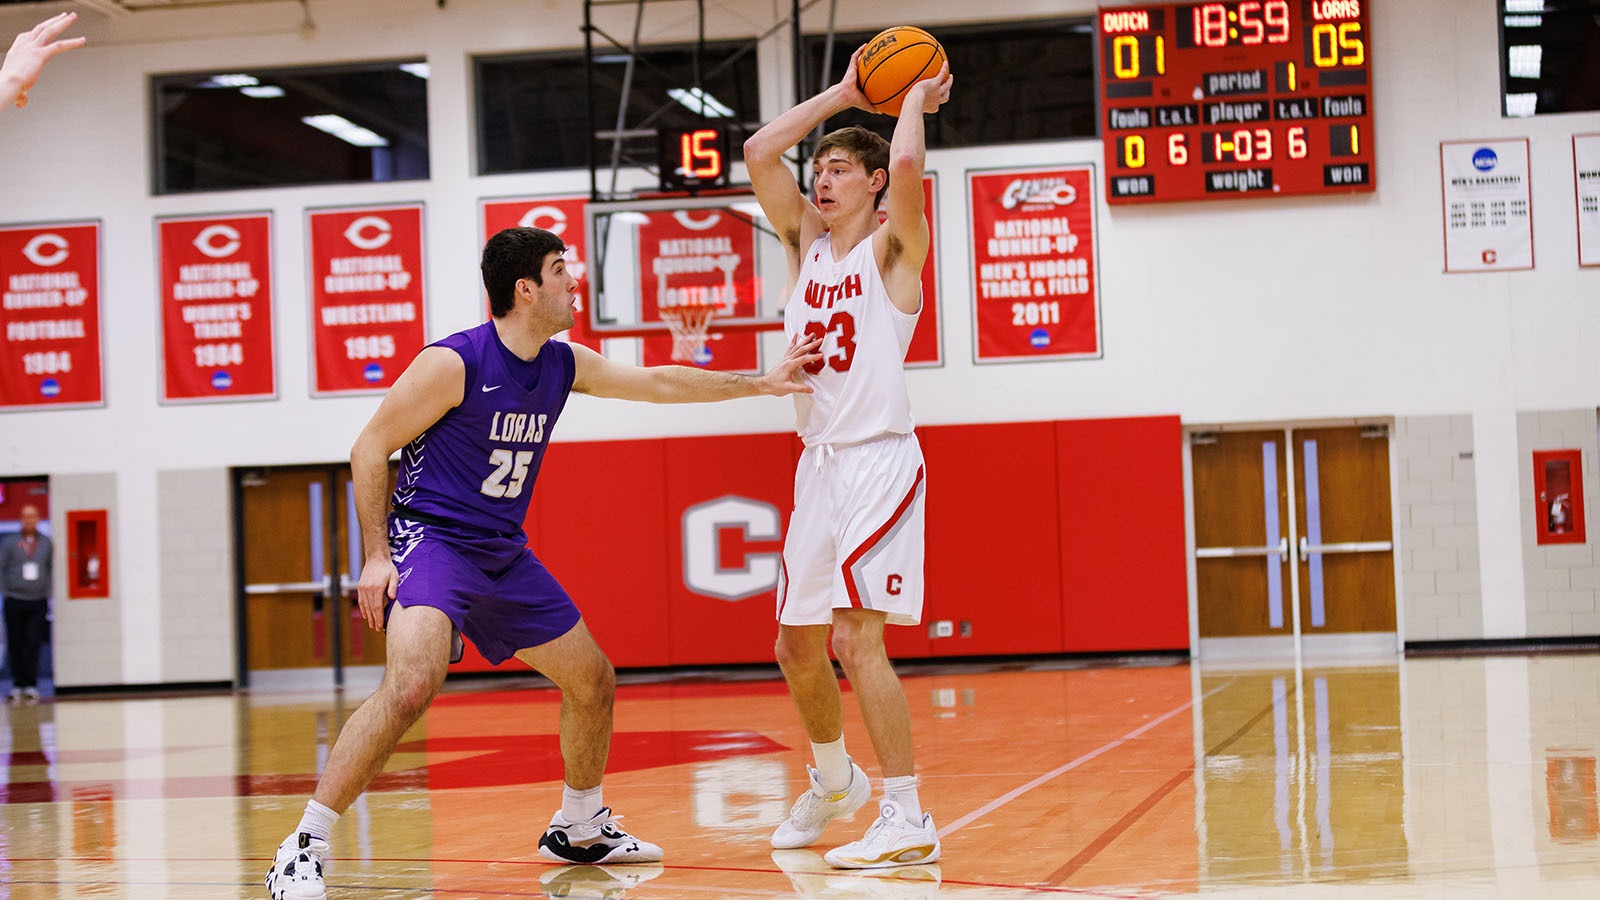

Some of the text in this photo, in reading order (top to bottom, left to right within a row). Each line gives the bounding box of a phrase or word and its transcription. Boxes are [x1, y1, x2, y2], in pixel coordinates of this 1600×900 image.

[1312, 0, 1360, 20] LORAS
[1103, 11, 1148, 33] DUTCH
[1193, 0, 1290, 46] 18:59
[863, 34, 897, 67] NCAA
[1312, 22, 1364, 67] 05
[1209, 70, 1261, 95] period
[1209, 102, 1262, 124] player
[1325, 96, 1362, 116] fouls
[1111, 108, 1148, 128] fouls
[1124, 135, 1145, 168] 0
[1168, 133, 1188, 165] 6
[1288, 127, 1307, 158] 6
[681, 129, 721, 179] 15
[1117, 177, 1148, 193] won
[1212, 169, 1264, 192] weight
[1331, 166, 1362, 183] won
[994, 217, 1070, 238] NATIONAL
[659, 236, 732, 256] NATIONAL
[988, 234, 1078, 256] RUNNER-UP
[180, 262, 252, 281] NATIONAL
[330, 255, 403, 275] NATIONAL
[981, 259, 1088, 280] MEN'S INDOOR
[9, 272, 80, 292] NATIONAL
[173, 279, 259, 300] RUNNER-UP
[324, 272, 411, 293] RUNNER-UP
[981, 277, 1089, 298] TRACK & FIELD
[3, 288, 88, 310] RUNNER-UP
[182, 303, 251, 323] WOMEN'S
[321, 302, 416, 326] WRESTLING
[1012, 301, 1060, 325] 2011
[7, 319, 86, 341] FOOTBALL
[194, 321, 242, 339] TRACK
[488, 411, 547, 443] LORAS
[480, 449, 534, 498] 25
[681, 494, 782, 602] C
[886, 573, 903, 596] C
